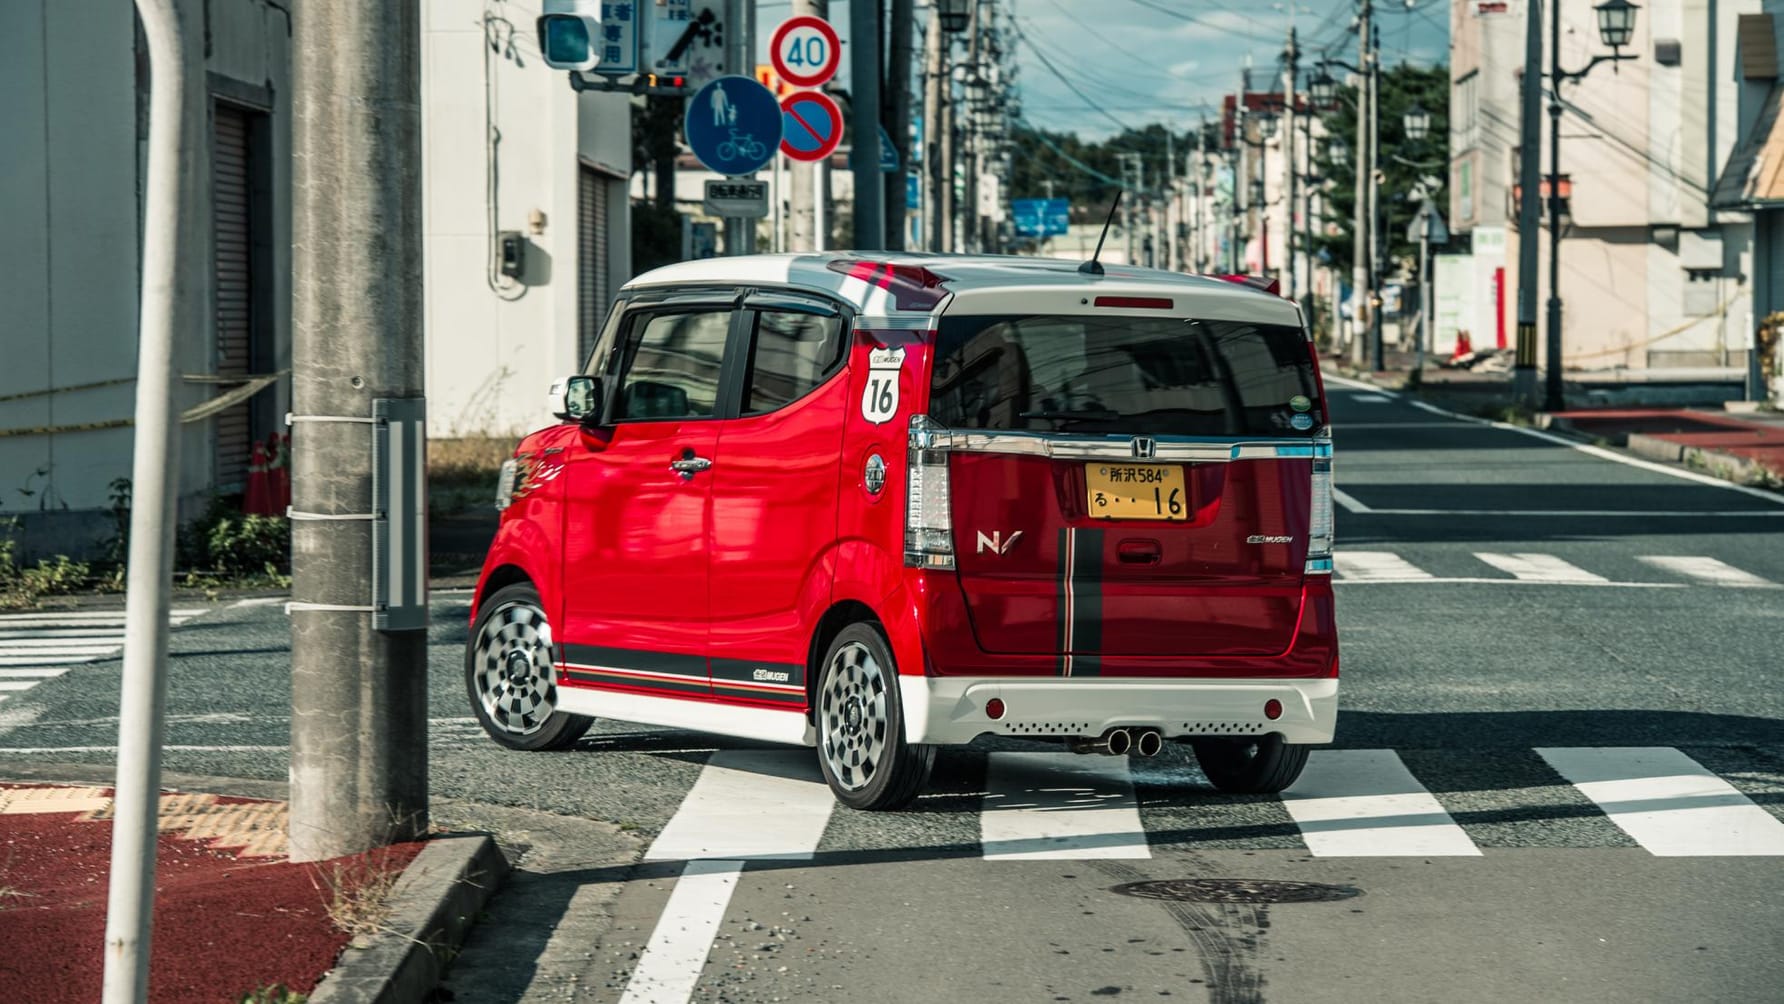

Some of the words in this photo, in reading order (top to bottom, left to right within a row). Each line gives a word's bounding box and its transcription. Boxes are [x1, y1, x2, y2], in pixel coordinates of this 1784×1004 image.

[787, 36, 825, 67] 40
[870, 379, 893, 414] 16
[1109, 467, 1163, 483] 所沢584
[1154, 487, 1181, 515] 16
